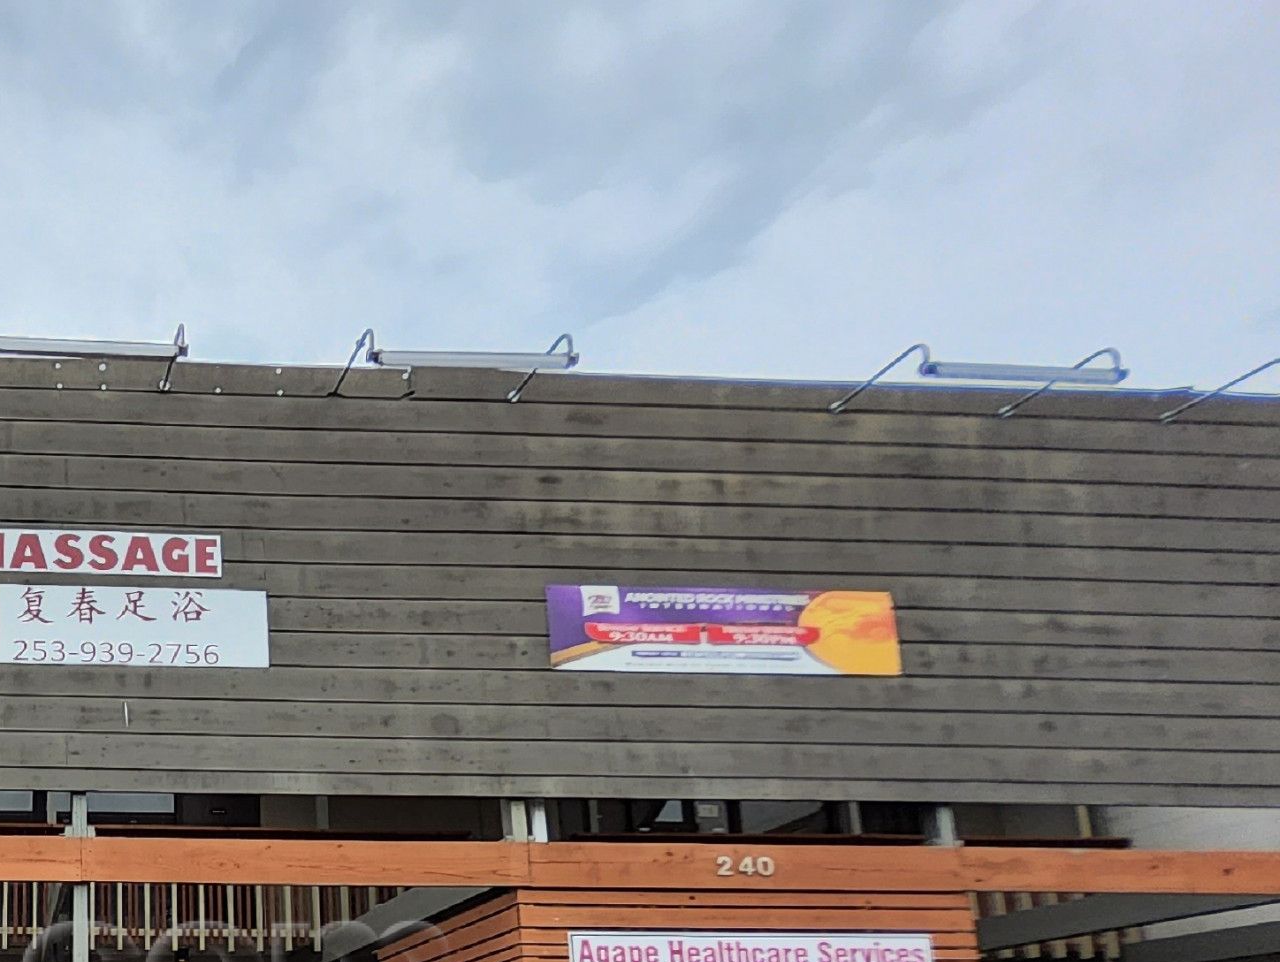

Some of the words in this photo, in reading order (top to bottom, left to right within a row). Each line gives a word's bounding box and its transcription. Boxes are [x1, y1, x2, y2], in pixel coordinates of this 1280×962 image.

[17, 586, 211, 625] 复春足浴
[12, 640, 220, 665] 253-939-2756
[716, 856, 775, 878] 240
